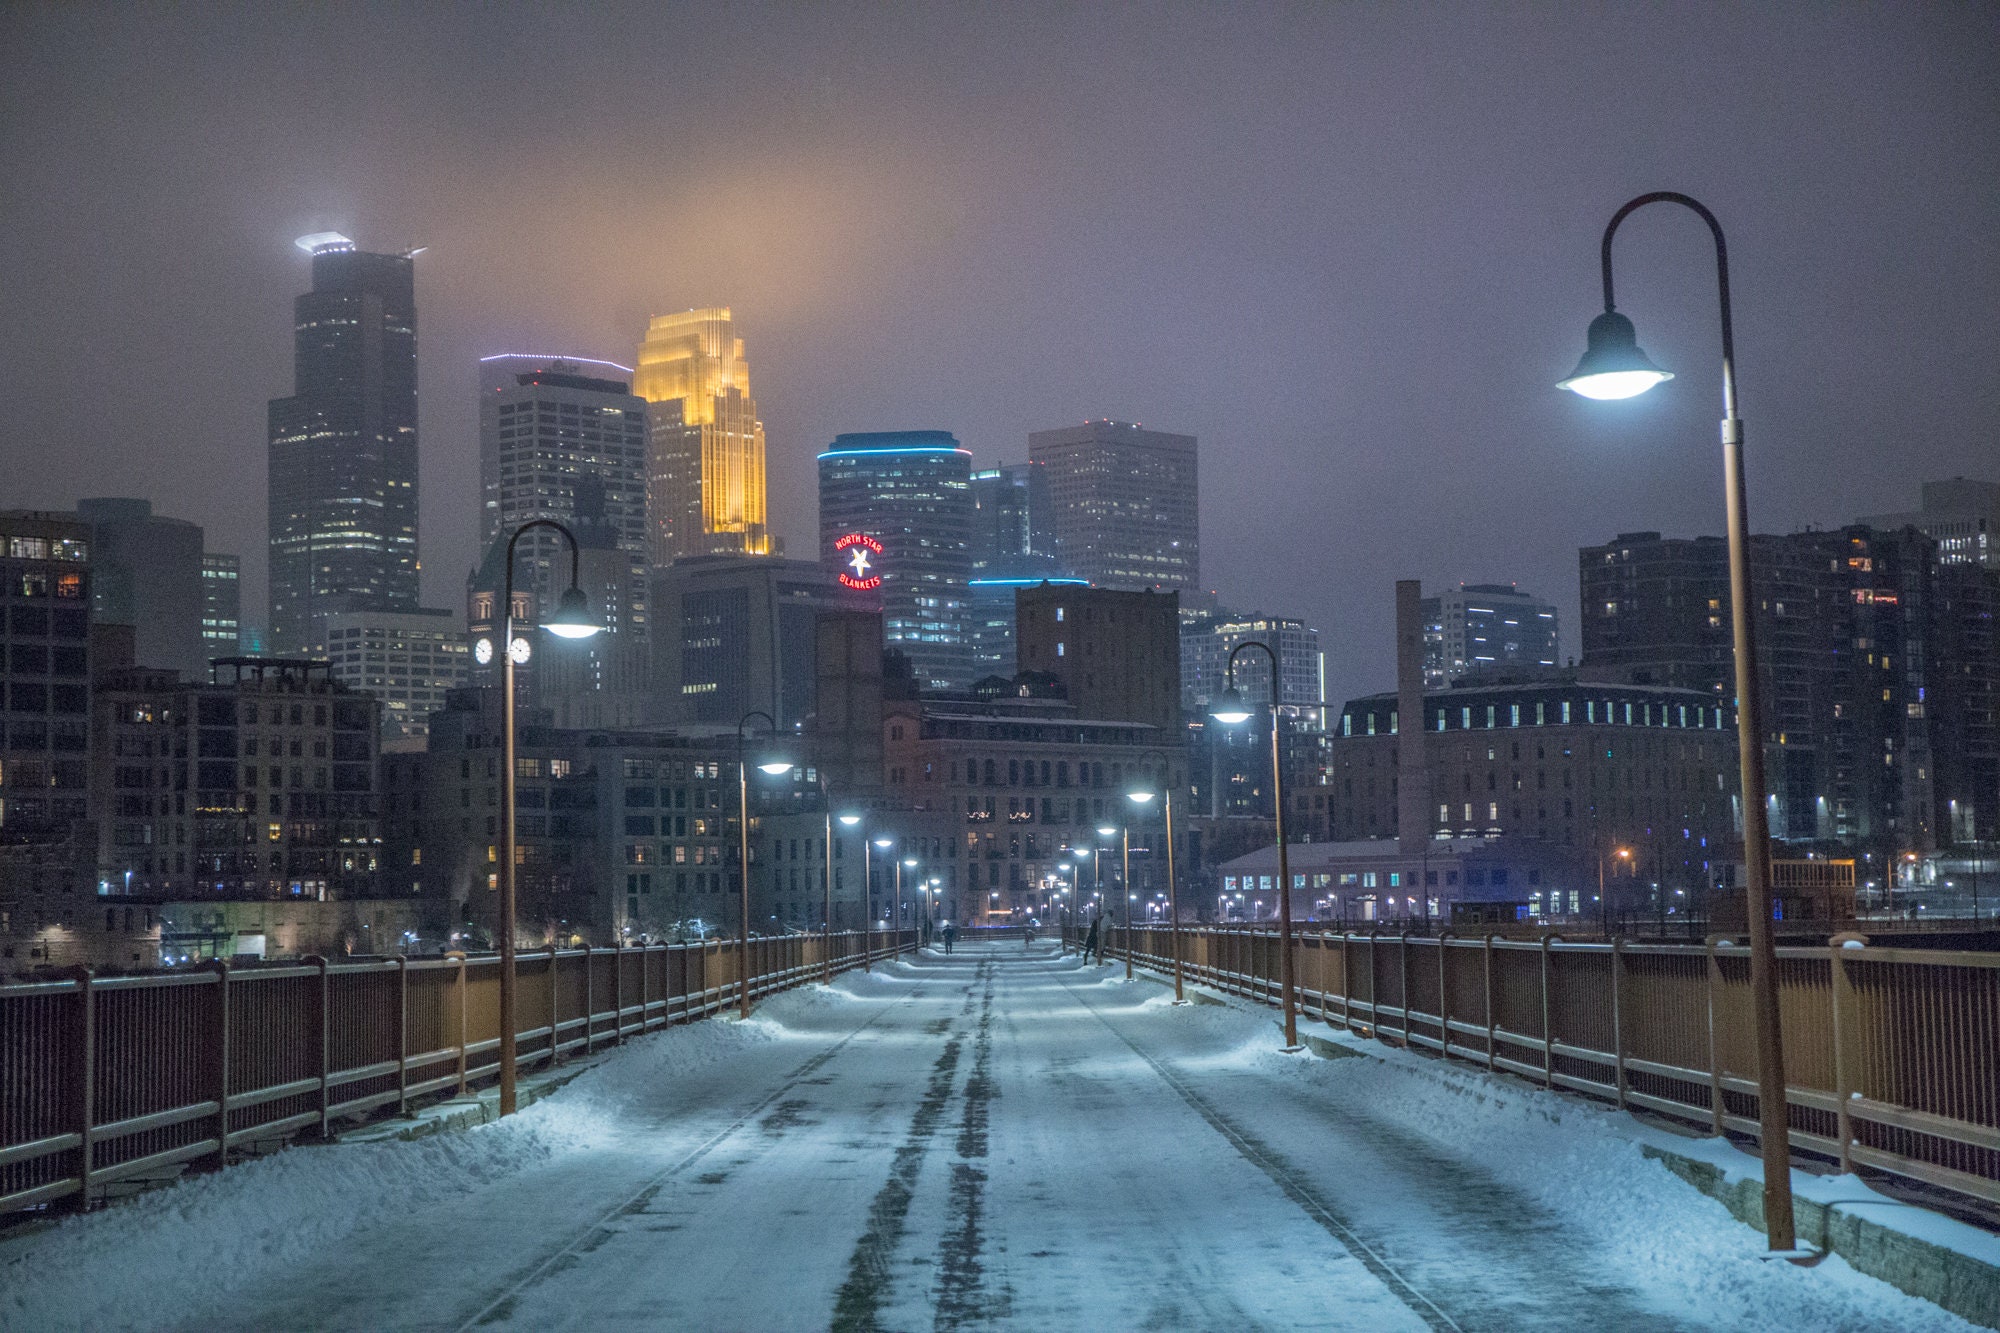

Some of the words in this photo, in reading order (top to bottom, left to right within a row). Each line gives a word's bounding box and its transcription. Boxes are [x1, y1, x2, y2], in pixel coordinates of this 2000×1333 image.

[835, 534, 861, 550] NORTH
[863, 536, 883, 554] STAR
[839, 573, 880, 589] BLANKETS
